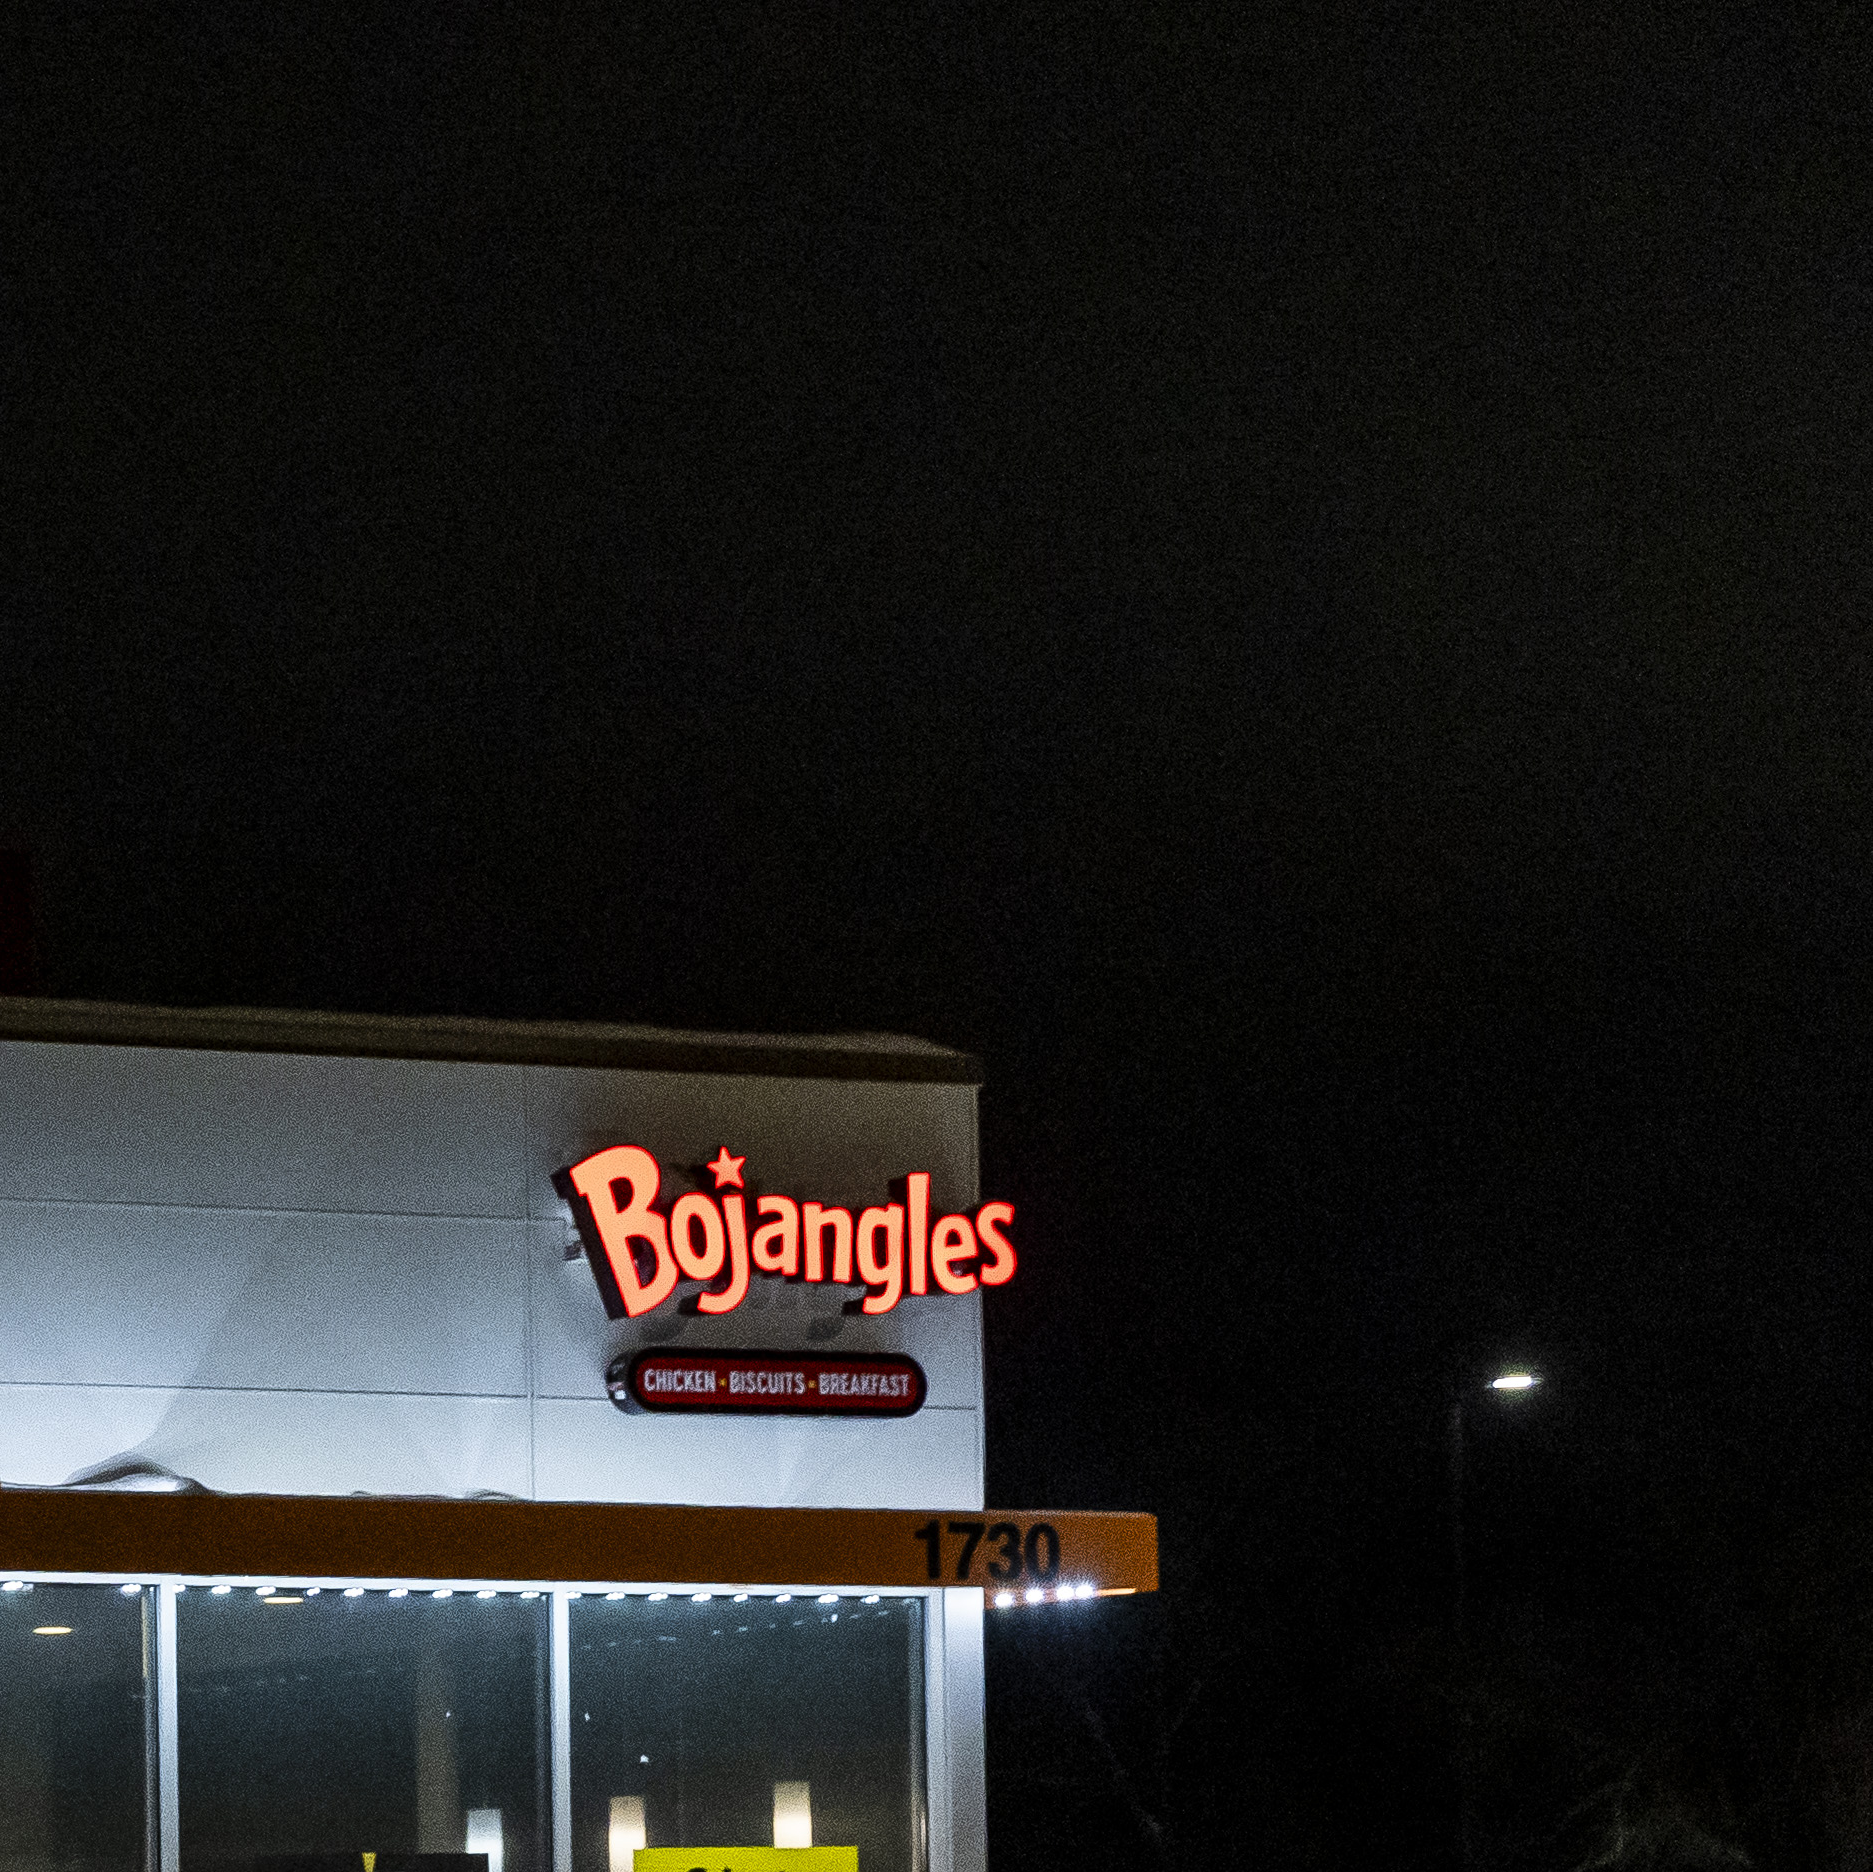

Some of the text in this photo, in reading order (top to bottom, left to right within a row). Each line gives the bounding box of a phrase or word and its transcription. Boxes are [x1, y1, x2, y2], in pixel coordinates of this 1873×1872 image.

[569, 1145, 1018, 1318] Bojangles
[643, 1368, 911, 1397] CHICKEN BISCUITS BREAKFAST
[914, 1519, 1060, 1582] 1730
